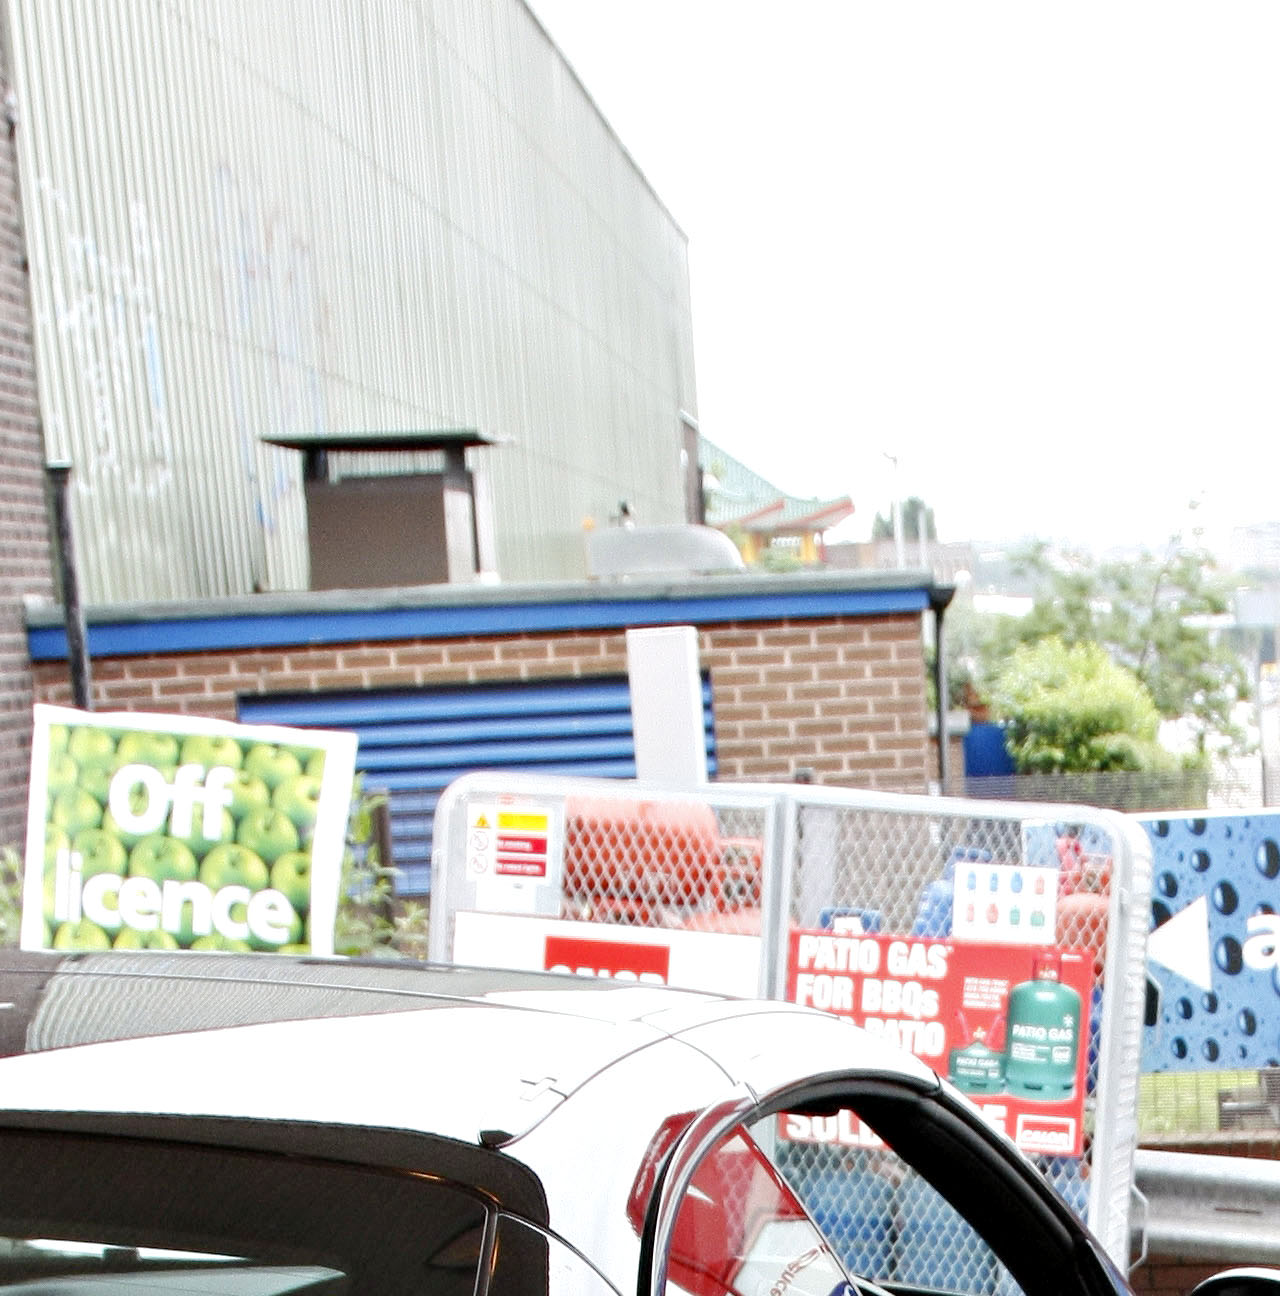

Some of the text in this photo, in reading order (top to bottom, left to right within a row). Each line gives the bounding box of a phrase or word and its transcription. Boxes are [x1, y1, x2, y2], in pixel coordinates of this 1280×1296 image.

[107, 762, 236, 841] Off
[53, 847, 297, 944] licence
[798, 934, 881, 974] PATIO
[796, 973, 854, 1011] FOR
[861, 978, 940, 1019] BBQs
[1012, 1024, 1073, 1042] PATIO GAS
